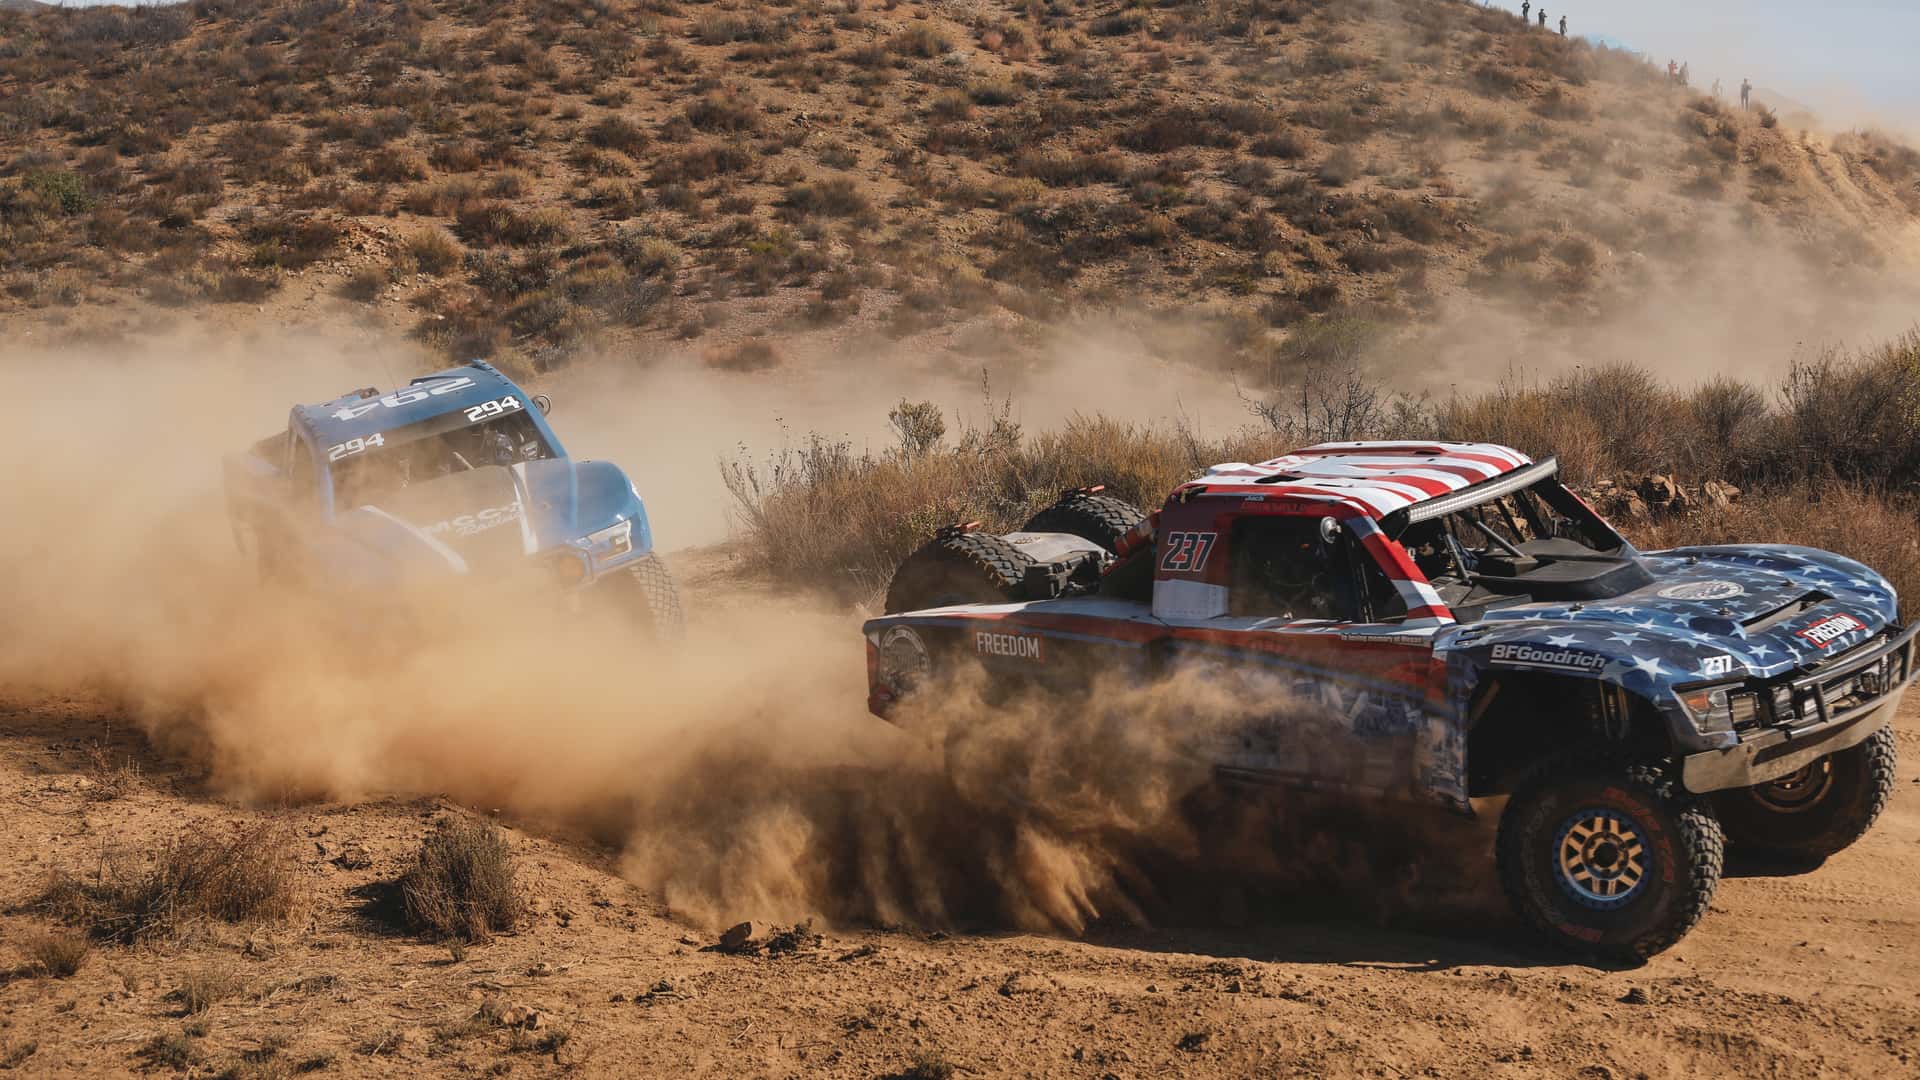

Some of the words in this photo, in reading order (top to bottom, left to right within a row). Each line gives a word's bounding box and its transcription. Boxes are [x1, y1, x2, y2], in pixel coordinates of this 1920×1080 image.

[464, 395, 520, 422] 294
[328, 433, 385, 462] 294
[1160, 531, 1217, 573] 237
[1801, 614, 1862, 644] FREEDOM
[976, 631, 1040, 658] FREEDOM
[1491, 644, 1607, 668] BFGoodrich
[1703, 655, 1732, 675] 237
